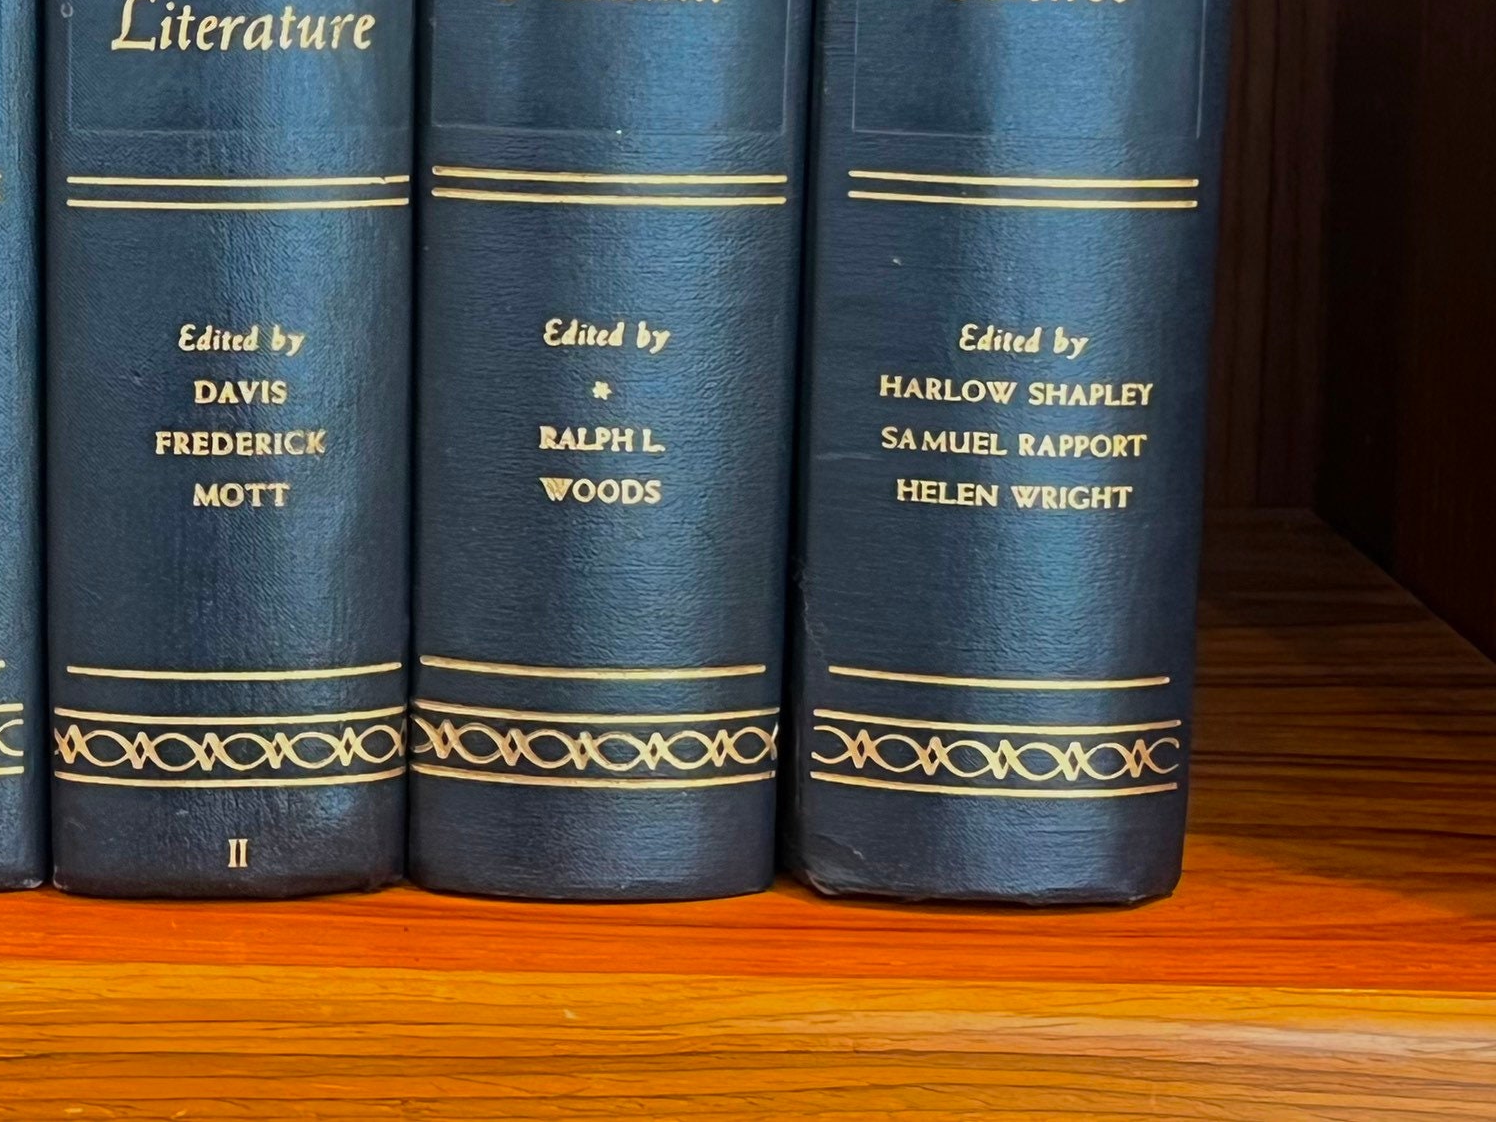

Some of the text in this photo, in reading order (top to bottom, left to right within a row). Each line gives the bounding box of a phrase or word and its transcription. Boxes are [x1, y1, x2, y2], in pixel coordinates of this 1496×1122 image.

[179, 323, 304, 355] Edited by
[542, 318, 672, 355] Edited by
[958, 323, 1089, 359] Edited by
[193, 379, 288, 405] DAVIS
[879, 374, 1154, 408] HARLOW SHAPLEY
[155, 430, 326, 457] FREDERICK
[538, 425, 636, 451] RALPH
[881, 425, 1149, 459] SAMUEL RAPPORT
[193, 482, 291, 508] MOTT
[539, 477, 662, 505] WOODS
[896, 478, 1135, 511] HELEN WRIGHT
